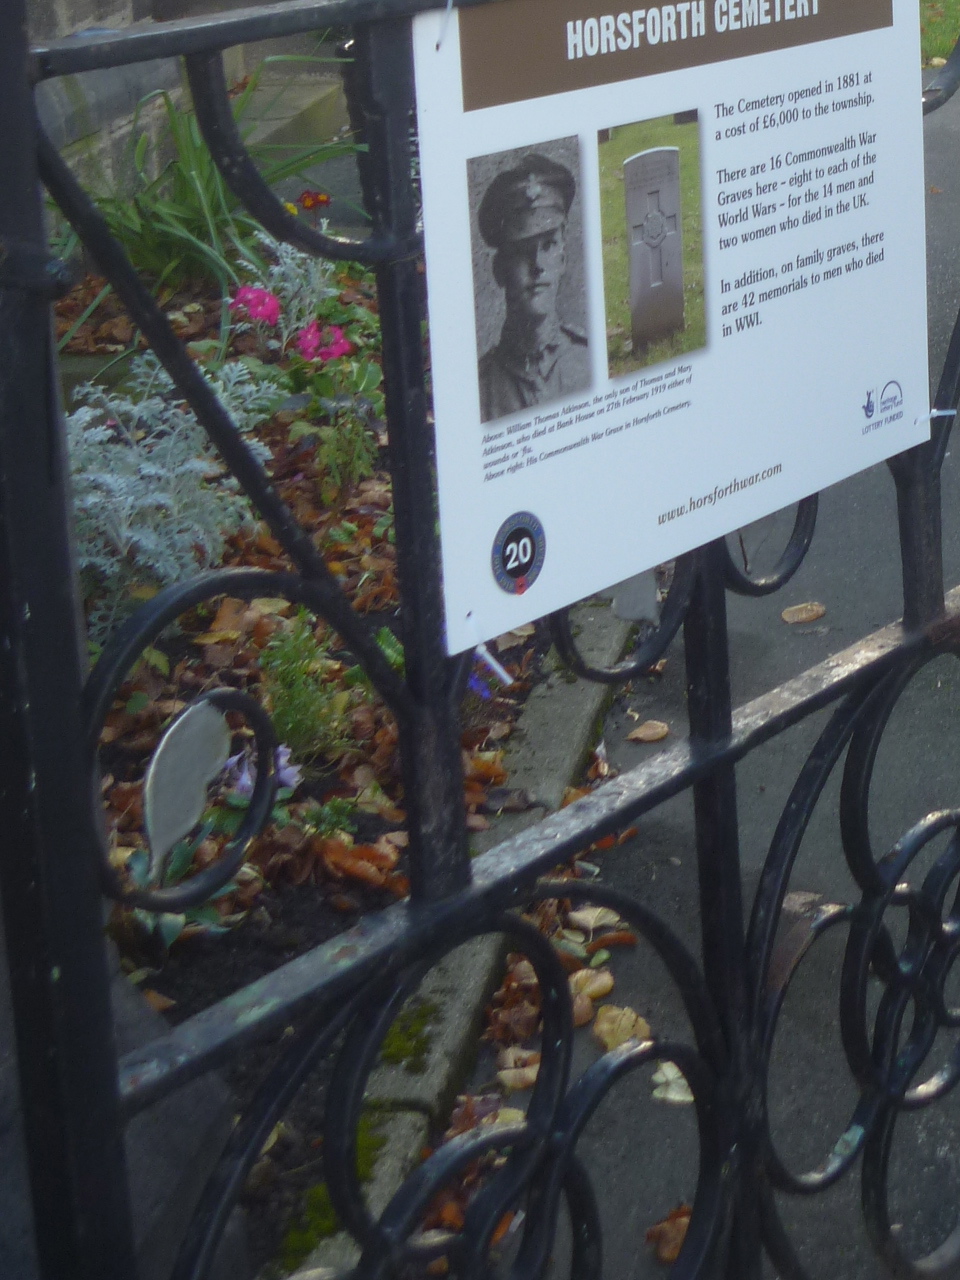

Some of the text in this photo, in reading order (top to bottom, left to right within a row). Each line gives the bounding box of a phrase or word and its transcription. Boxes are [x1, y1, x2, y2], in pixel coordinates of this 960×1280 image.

[566, 0, 706, 60] HORSFORTH
[714, 71, 872, 119] The Cemetery opened in 1881 at
[715, 94, 875, 140] a cost of £6,000 to the township.
[716, 130, 877, 184] There are 16 Commonwealth War
[718, 188, 752, 206] Graves
[756, 178, 778, 197] here
[789, 170, 813, 190] eight
[815, 167, 825, 179] to
[828, 156, 848, 176] each
[851, 155, 861, 169] of
[863, 152, 877, 165] the
[718, 209, 748, 228] World
[751, 202, 777, 217] Wars
[788, 194, 801, 210] for
[804, 187, 819, 203] the
[823, 183, 833, 198] 14
[836, 181, 855, 195] men
[858, 171, 875, 188] and
[719, 193, 870, 250] two women who died in the UK.
[720, 230, 885, 294] In addition, on family graves, there
[721, 249, 885, 315] are 42 memorials to men who died
[722, 311, 762, 338] in WWI.
[507, 422, 531, 435] William
[534, 411, 559, 426] Thomas
[561, 401, 590, 416] Atkinson,
[593, 396, 603, 405] the
[605, 390, 617, 400] only
[632, 382, 638, 391] of
[640, 375, 663, 388] Thomas
[665, 368, 676, 379] and
[677, 365, 692, 375] Mary
[517, 436, 530, 445] who
[532, 427, 546, 439] died
[557, 418, 573, 430] Bank
[575, 411, 594, 422] House
[606, 401, 620, 412] 27th
[622, 391, 649, 407] February
[651, 384, 666, 396] 1919
[668, 379, 684, 389] either
[686, 374, 692, 384] of
[862, 411, 903, 435] LOTTERY FUNDED
[483, 454, 509, 469] wounds
[511, 451, 518, 459] or
[484, 469, 505, 482] Above
[526, 456, 537, 466] His
[539, 436, 589, 461] Commonwealth
[591, 432, 603, 441] War
[605, 425, 623, 436] Grave
[632, 410, 661, 427] Horsforth
[658, 463, 782, 525] www.horsforthwar.com
[505, 537, 531, 570] 20
